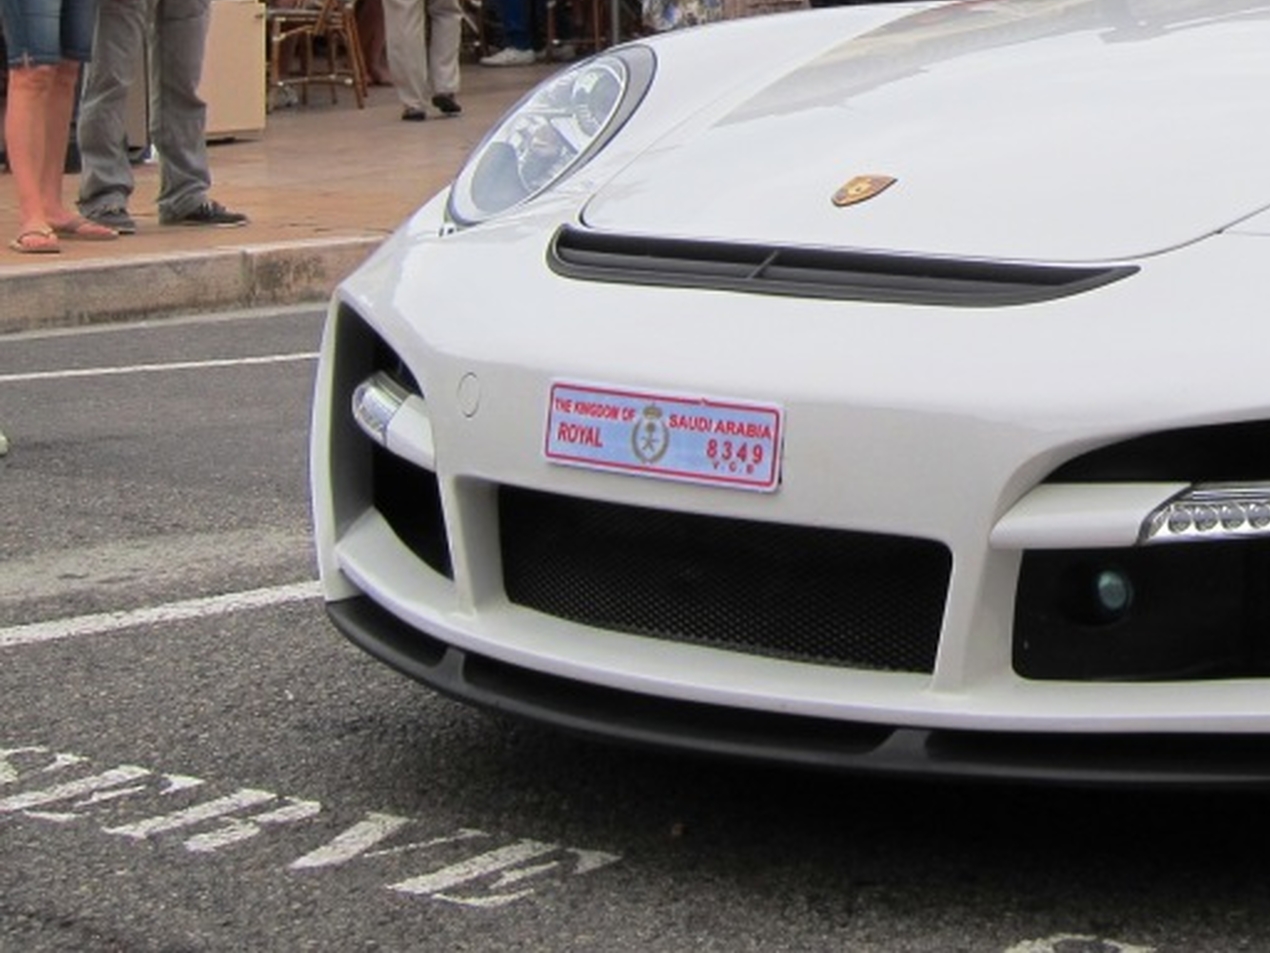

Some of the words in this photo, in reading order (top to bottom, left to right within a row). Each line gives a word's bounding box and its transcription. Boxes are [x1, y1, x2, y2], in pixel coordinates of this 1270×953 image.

[555, 397, 572, 414] THE
[574, 401, 619, 421] KINGDOM
[621, 406, 636, 422] OF
[668, 413, 713, 433] SAUDI
[714, 419, 772, 440] ARABIA
[557, 421, 604, 448] ROYAL
[706, 437, 763, 465] 8349
